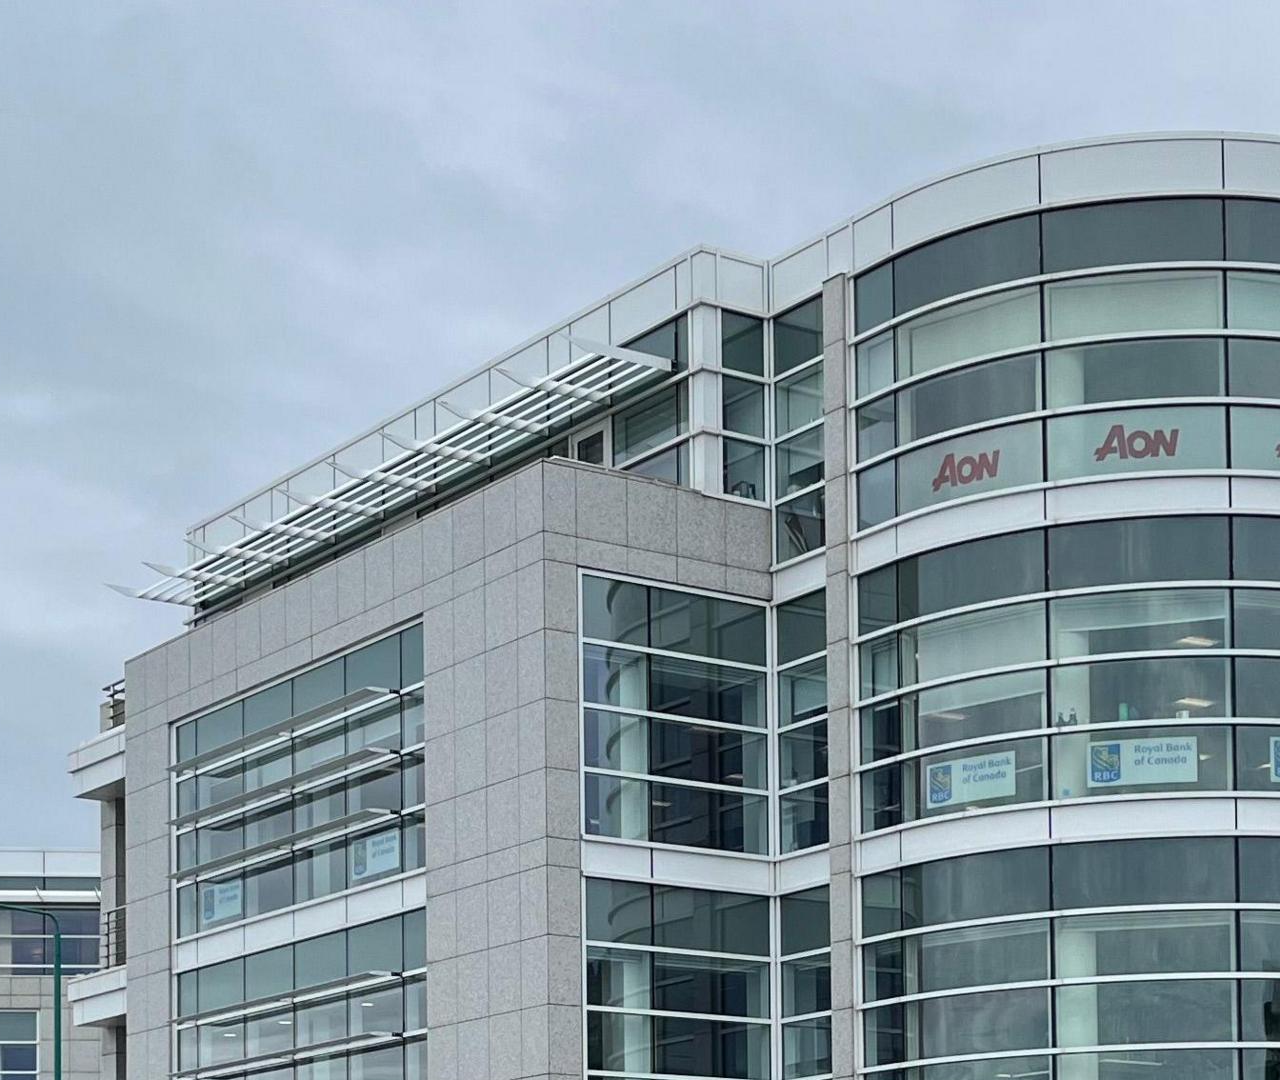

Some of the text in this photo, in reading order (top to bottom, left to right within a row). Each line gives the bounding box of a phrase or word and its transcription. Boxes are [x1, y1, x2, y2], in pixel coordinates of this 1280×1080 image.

[1134, 742, 1193, 755] Royal Bank
[962, 756, 1012, 773] Royal Bank
[1134, 755, 1187, 766] of Canada
[962, 770, 1007, 784] of Canada
[1094, 770, 1119, 781] RBC
[931, 790, 950, 802] RBC
